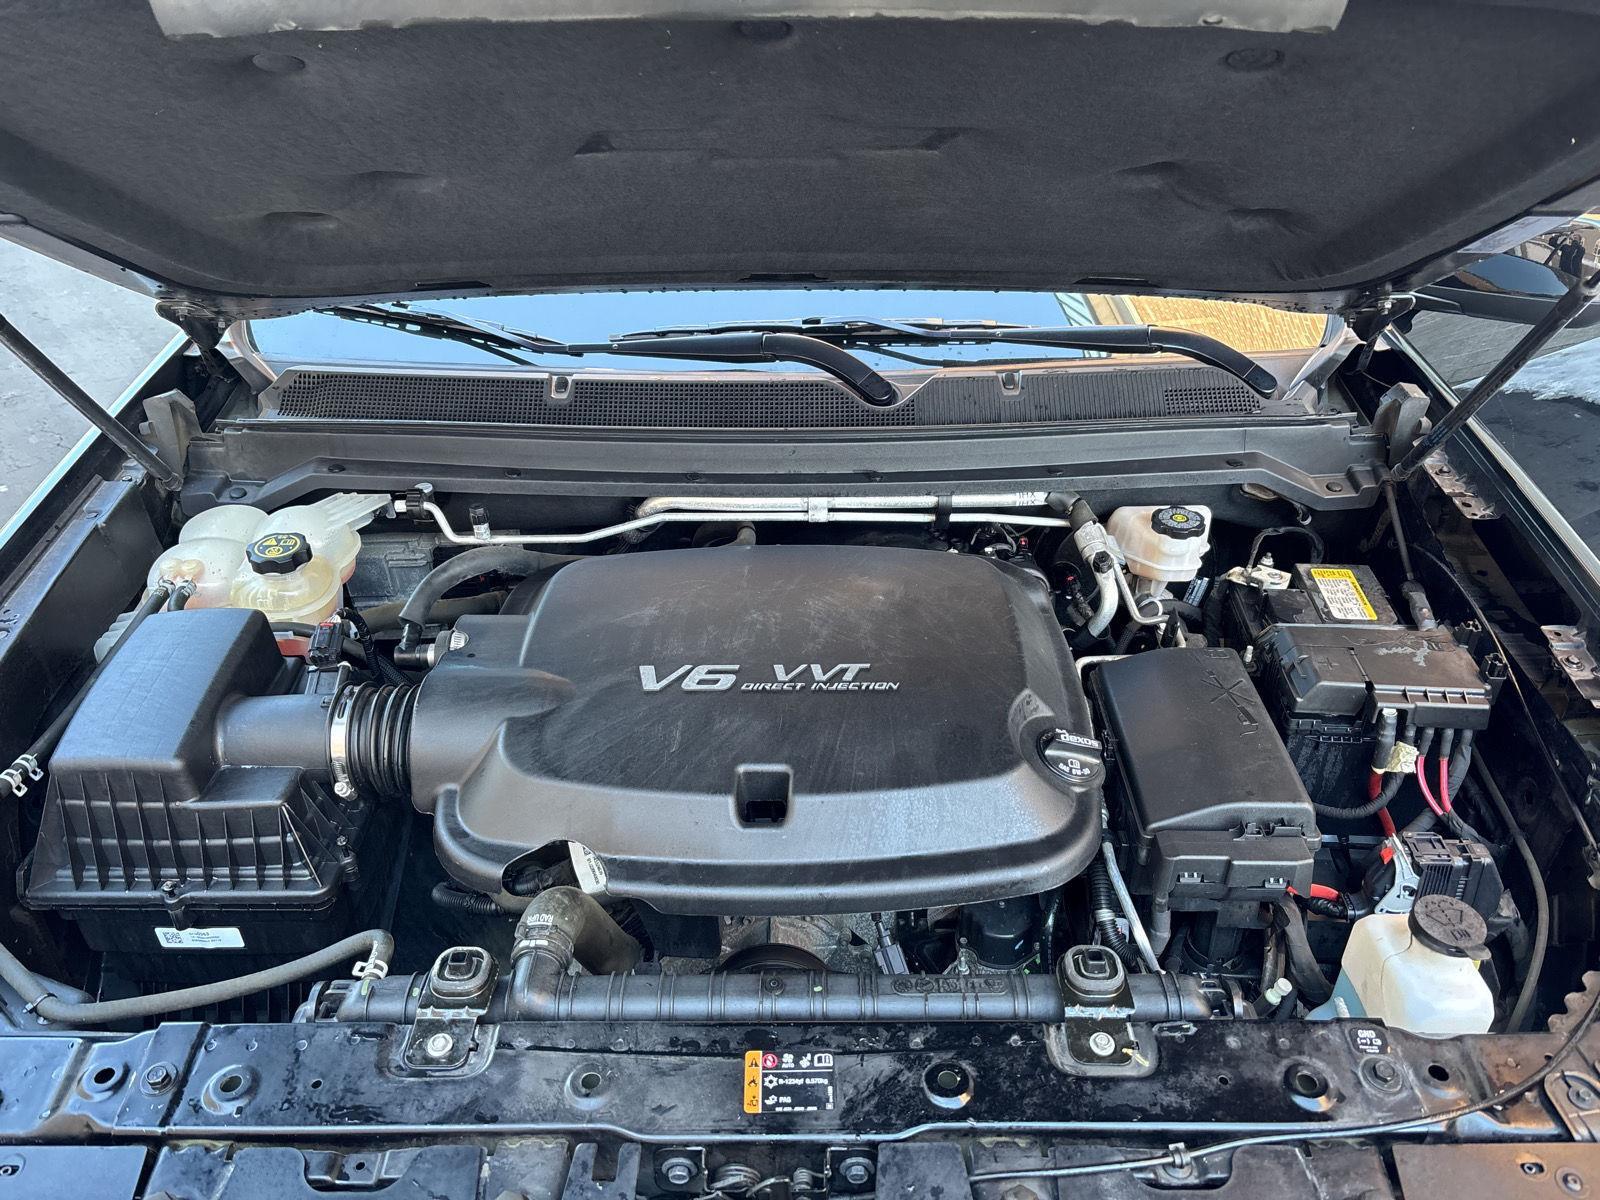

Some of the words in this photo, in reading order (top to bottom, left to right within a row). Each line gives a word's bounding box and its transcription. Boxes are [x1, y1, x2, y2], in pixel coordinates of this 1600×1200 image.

[639, 664, 740, 692] V6
[773, 663, 871, 682] VVT
[741, 682, 805, 691] DIRECT
[810, 681, 900, 691] INJECTION
[1060, 730, 1099, 747] dexos
